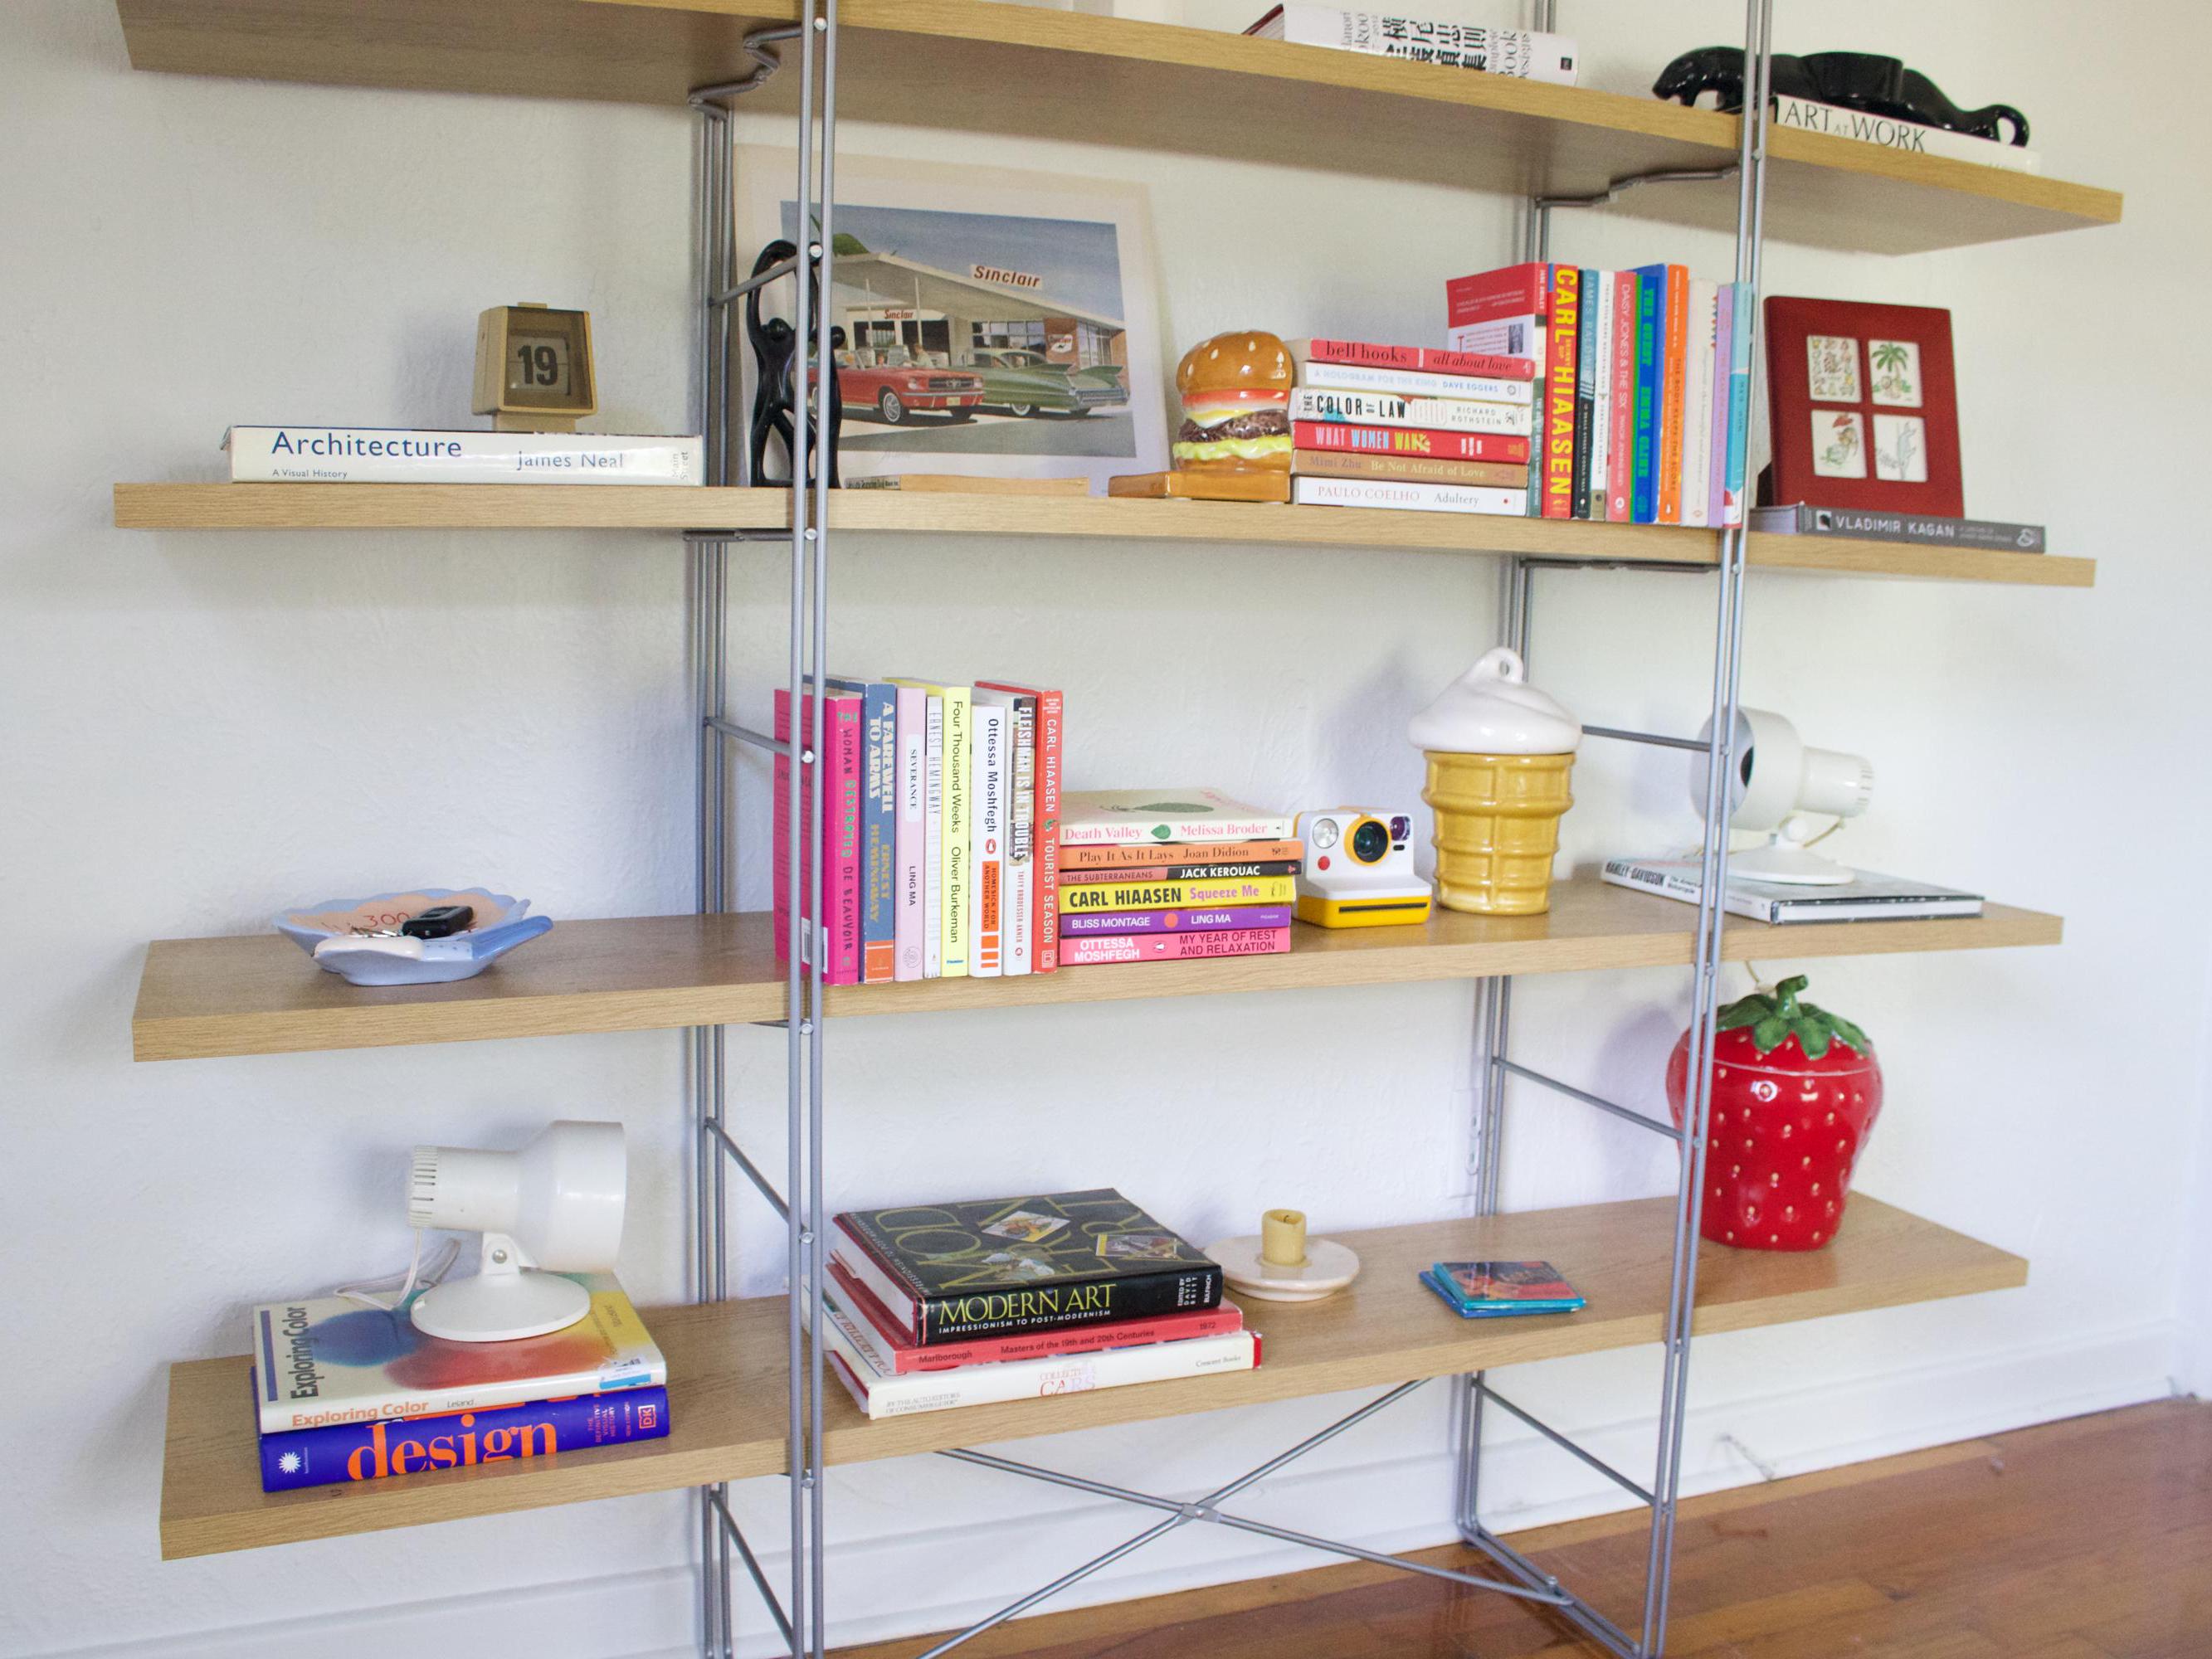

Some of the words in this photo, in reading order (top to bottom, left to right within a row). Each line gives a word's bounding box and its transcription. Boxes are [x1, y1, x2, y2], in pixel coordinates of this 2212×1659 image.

[1785, 100, 1833, 132] ART
[1834, 124, 1849, 135] AT
[1851, 113, 1928, 153] WORK
[973, 265, 1040, 289] Sinclair
[884, 309, 914, 319] Sinclair
[1553, 268, 1578, 343] CARL
[1620, 284, 1630, 316] DAISY
[1620, 318, 1630, 358] JONES
[517, 344, 558, 387] 19
[1326, 341, 1357, 358] bell
[1359, 343, 1407, 363] hooks
[1433, 353, 1451, 367] all
[1452, 354, 1487, 369] about
[1488, 357, 1513, 372] love
[1620, 358, 1629, 367] &
[1442, 380, 1464, 392] DAVE
[1466, 382, 1498, 392] EGGERS
[1619, 371, 1628, 389] THE
[1303, 395, 1313, 412] THE
[1317, 395, 1363, 416] COLOR
[1367, 403, 1375, 413] OF
[1379, 400, 1406, 419] LAW
[1455, 406, 1497, 416] RICHARD
[1619, 392, 1627, 408] SIX
[1451, 416, 1502, 426] ROTHSTEIN
[1549, 365, 1576, 494] HIAASEN
[271, 431, 462, 457] Architecture
[580, 453, 624, 469] Neal
[1315, 426, 1346, 446] WHAT
[1351, 428, 1390, 450] WOMEN
[272, 469, 280, 478] A
[281, 469, 309, 478] Visual
[312, 469, 348, 480] History
[1371, 460, 1386, 471] Be
[1387, 461, 1407, 473] Not
[1410, 462, 1445, 475] Afraid
[1447, 465, 1459, 476] of
[1465, 466, 1486, 478] Love
[1318, 485, 1361, 499] PAULO
[1364, 489, 1420, 503] COELHO
[1434, 493, 1480, 508] Adultery
[1834, 515, 1902, 533] VLADIMIR
[1907, 521, 1955, 538] KAGAN
[882, 701, 894, 718] A
[953, 700, 963, 728] Four
[869, 716, 881, 742] TO
[928, 713, 942, 748] ERNEST
[987, 718, 999, 767] Ottessa
[1016, 707, 1033, 772] FLEISHMAN
[1046, 718, 1057, 752] CARL
[843, 727, 853, 775] WOMAN
[952, 732, 962, 791] Thousand
[869, 744, 880, 799] ARMS
[881, 721, 894, 814] FAREWELL
[909, 748, 918, 810] SEVERANCE
[928, 757, 942, 814] HEMINGWAY
[1016, 776, 1030, 788] IS
[1045, 756, 1056, 812] HIAASEN
[985, 771, 998, 832] Moshfegh
[1015, 791, 1030, 804] IN
[840, 780, 856, 859] DESTROYED
[952, 793, 962, 834] Weeks
[1013, 805, 1030, 858] TROUBLE
[1065, 825, 1102, 839] Death
[1105, 823, 1143, 841] Valley
[1181, 821, 1224, 837] Melissa
[1227, 820, 1268, 834] Broder
[951, 846, 962, 882] Oliver
[1044, 837, 1055, 890] TOURIST
[1079, 852, 1102, 865] Play
[1106, 851, 1115, 861] It
[1119, 850, 1133, 861] As
[1137, 850, 1145, 860] It
[1148, 849, 1174, 864] Lays
[1182, 848, 1209, 859] Joan
[1212, 847, 1249, 858] Didion
[843, 866, 853, 882] DE
[870, 823, 879, 923] HEMINGWAY
[909, 865, 917, 889] LING
[1067, 873, 1082, 883] THE
[1084, 871, 1153, 882] SUBTERRANEANS
[1180, 868, 1208, 879] JACK
[1210, 865, 1261, 878] KEROUAC
[908, 891, 917, 907] MA
[1069, 892, 1108, 907] CARL
[1114, 888, 1182, 905] HIAASEN
[1189, 888, 1237, 902] Squeeze
[1241, 885, 1259, 897] Me
[363, 912, 410, 929] 300
[842, 888, 854, 951] BEAUVOIR
[950, 884, 961, 943] Burkeman
[1043, 895, 1055, 943] SEASON
[1071, 919, 1100, 929] BLISS
[1101, 917, 1151, 927] MONTAGE
[1191, 915, 1214, 925] LING
[1215, 914, 1231, 923] MA
[1079, 937, 1134, 951] OTTESSA
[1179, 935, 1197, 945] MY
[1198, 933, 1228, 944] YEAR
[1231, 932, 1247, 941] OF
[1249, 930, 1278, 941] REST
[1180, 946, 1204, 956] AND
[1206, 941, 1276, 956] RELAXATION
[1074, 948, 1140, 963] MOSHFEGH
[1179, 1277, 1185, 1286] BY
[1203, 1273, 1212, 1303] BULFINCH
[938, 1288, 1059, 1326] MODERN
[1065, 1283, 1118, 1313] ART
[282, 1306, 309, 1338] Color
[938, 1320, 1013, 1335] IMPRESSIONISM
[1016, 1318, 1028, 1326] TO
[1031, 1310, 1111, 1324] POST-MODERNISM
[918, 1350, 972, 1364] Marlborough
[1001, 1345, 1035, 1355] Masters
[1035, 1341, 1045, 1350] of
[1046, 1340, 1059, 1350] the
[1061, 1336, 1078, 1347] 19th
[1079, 1335, 1095, 1345] and
[1097, 1334, 1114, 1343] 20th
[1116, 1330, 1155, 1341] Centuries
[1199, 1321, 1216, 1331] 1972
[285, 1336, 325, 1399] Exploring
[1195, 1356, 1221, 1368] Crescent
[1222, 1354, 1242, 1365] Books
[292, 1406, 378, 1428] Exploring
[381, 1399, 429, 1419] Color
[642, 1406, 652, 1427] DK
[346, 1413, 559, 1482] design
